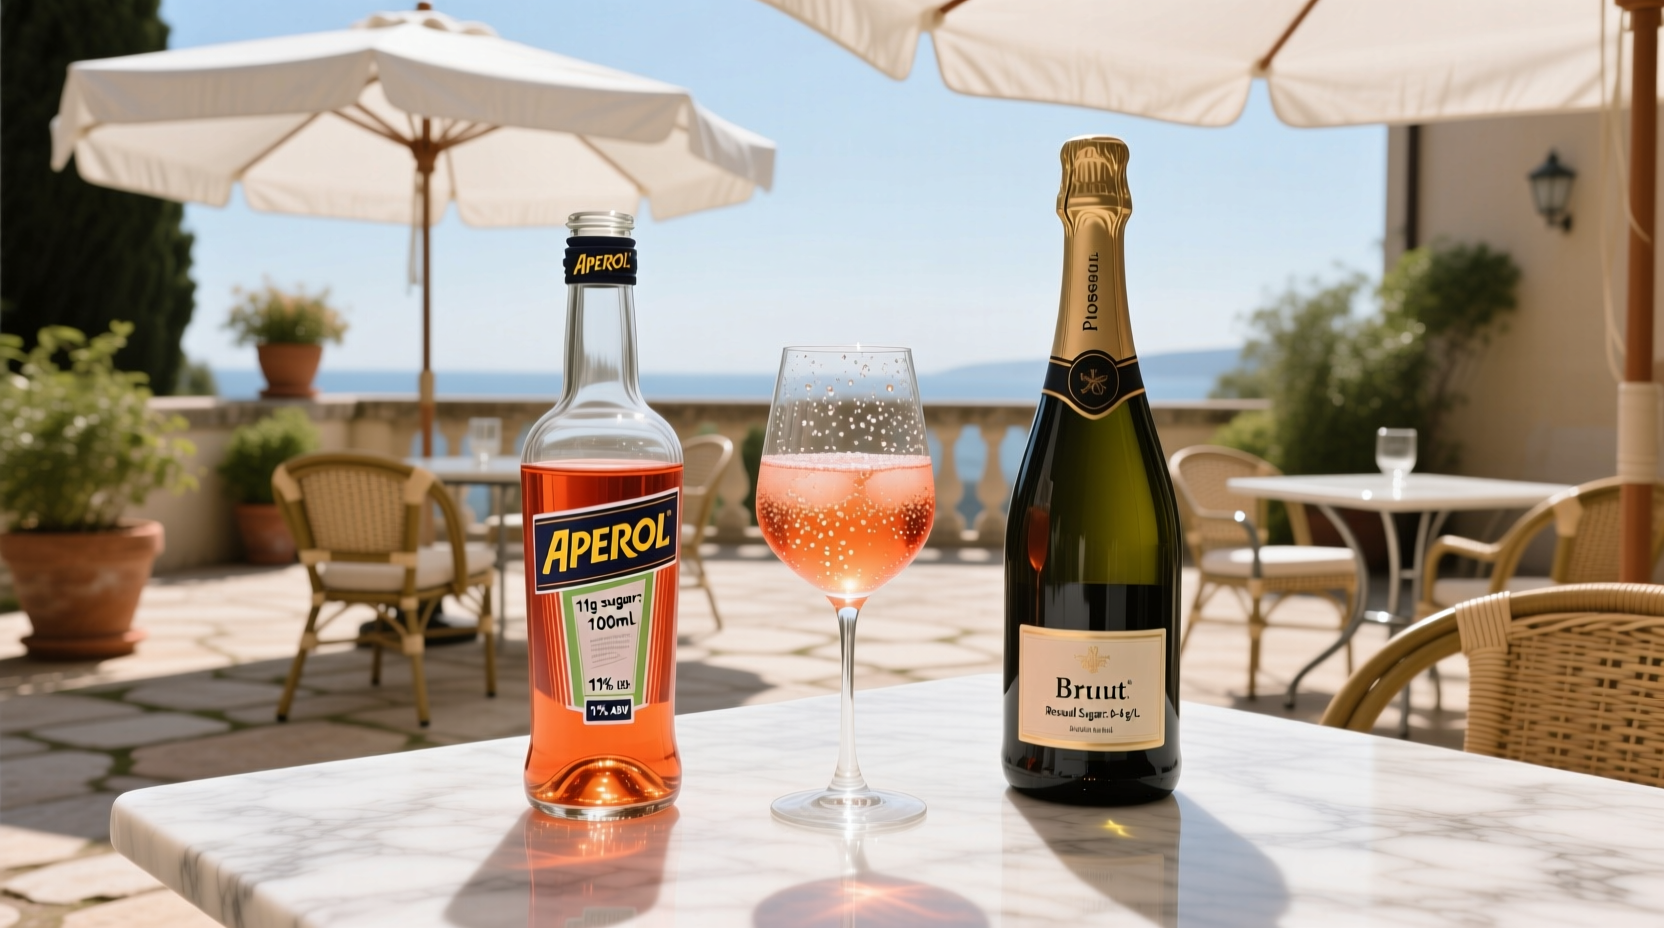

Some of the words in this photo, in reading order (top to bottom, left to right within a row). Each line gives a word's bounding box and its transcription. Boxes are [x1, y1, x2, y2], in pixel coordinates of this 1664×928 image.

[573, 252, 631, 275] APEROL
[542, 512, 669, 575] APEROL
[576, 598, 597, 614] 11g
[588, 611, 636, 630] 100ml
[610, 705, 629, 715] ABV
